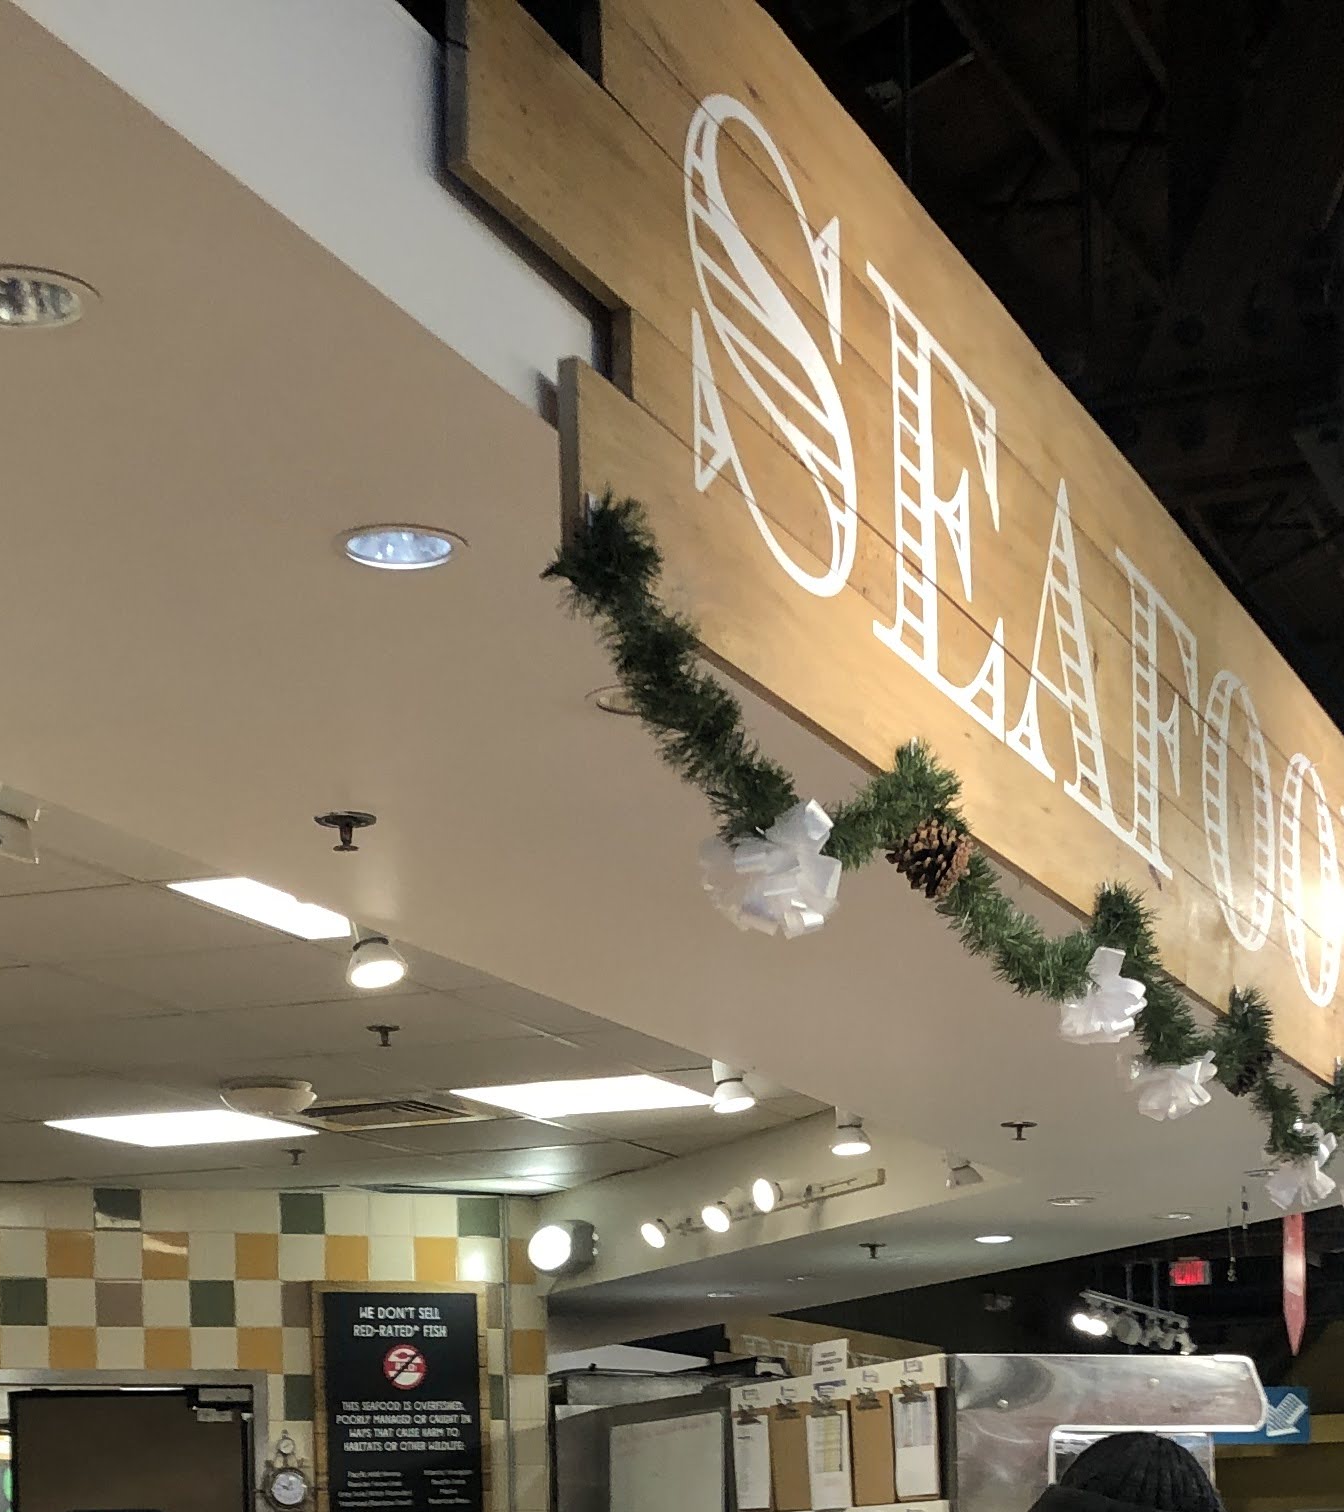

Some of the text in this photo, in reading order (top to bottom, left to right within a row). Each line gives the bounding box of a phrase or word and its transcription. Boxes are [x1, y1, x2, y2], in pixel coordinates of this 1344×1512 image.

[359, 1306, 441, 1320] WE DON'T SELL
[423, 1325, 448, 1337] FISH
[342, 1401, 360, 1411] THIS
[362, 1401, 401, 1411] SEAFOOD
[403, 1401, 412, 1411] IS
[336, 1414, 473, 1425] POORLY MANAGED OR CAUGHT IN
[349, 1427, 460, 1439] WAYS THAT CAUSE HARM TO
[343, 1442, 383, 1452] HABITATS
[384, 1441, 398, 1451] OR
[399, 1441, 427, 1451] OTHER
